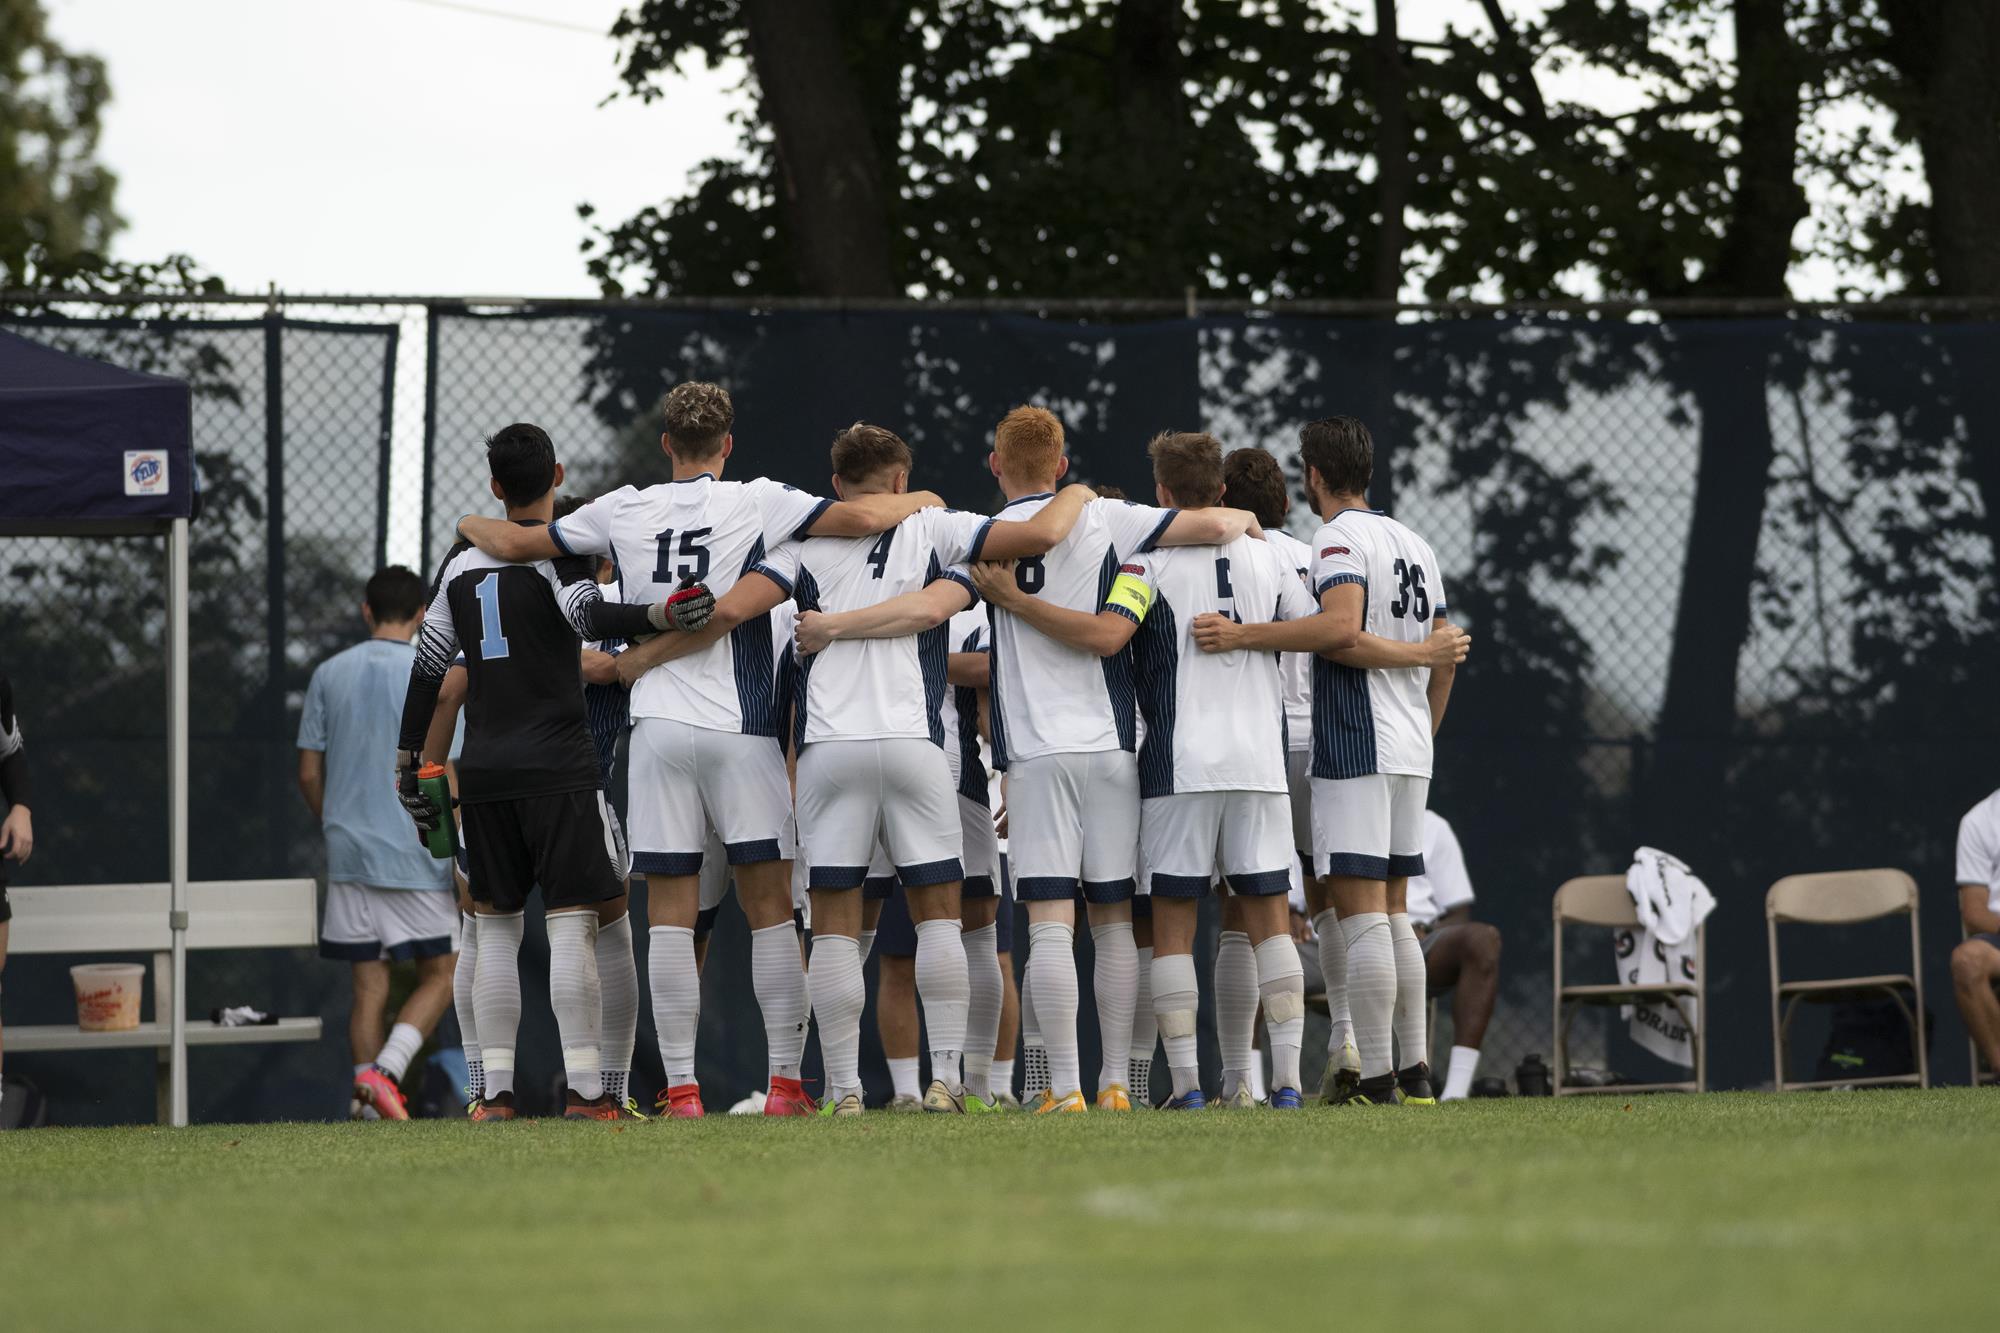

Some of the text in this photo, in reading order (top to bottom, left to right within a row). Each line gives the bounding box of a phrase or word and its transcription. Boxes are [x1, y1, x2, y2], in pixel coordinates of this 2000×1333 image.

[652, 527, 712, 584] 15
[867, 525, 898, 579] 4
[1015, 553, 1045, 594] 8
[475, 572, 509, 660] 1
[1391, 558, 1430, 623] 36
[1636, 1005, 1688, 1043] ORADE
